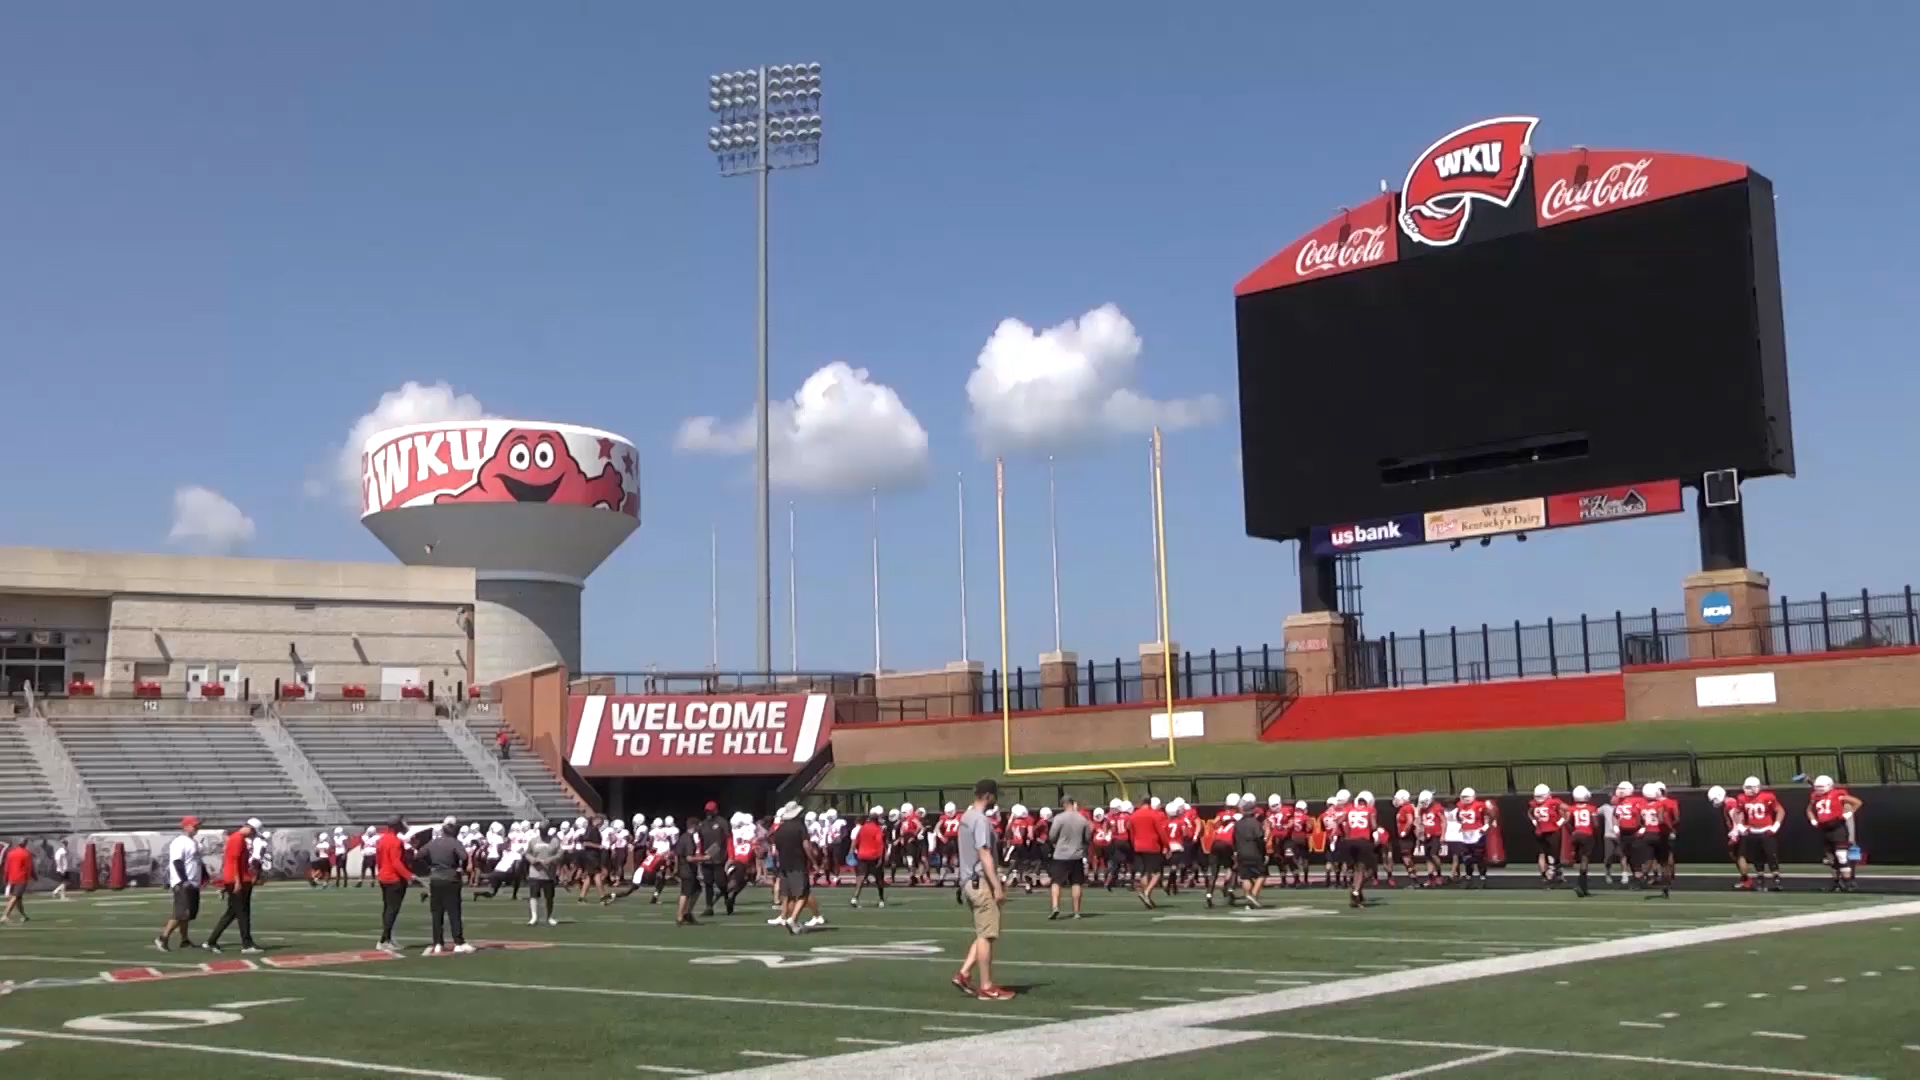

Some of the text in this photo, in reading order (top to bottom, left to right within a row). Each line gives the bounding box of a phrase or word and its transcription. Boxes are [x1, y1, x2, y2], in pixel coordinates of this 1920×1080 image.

[1434, 141, 1502, 179] WKU
[373, 430, 485, 506] WKU
[1461, 516, 1512, 532] Kentucky's
[1514, 513, 1541, 525] Dairy
[1482, 507, 1499, 517] We
[611, 701, 788, 731] WELCOME
[613, 731, 788, 757] TO THE HILL
[1573, 809, 1590, 827] 19
[1744, 803, 1766, 819] 70
